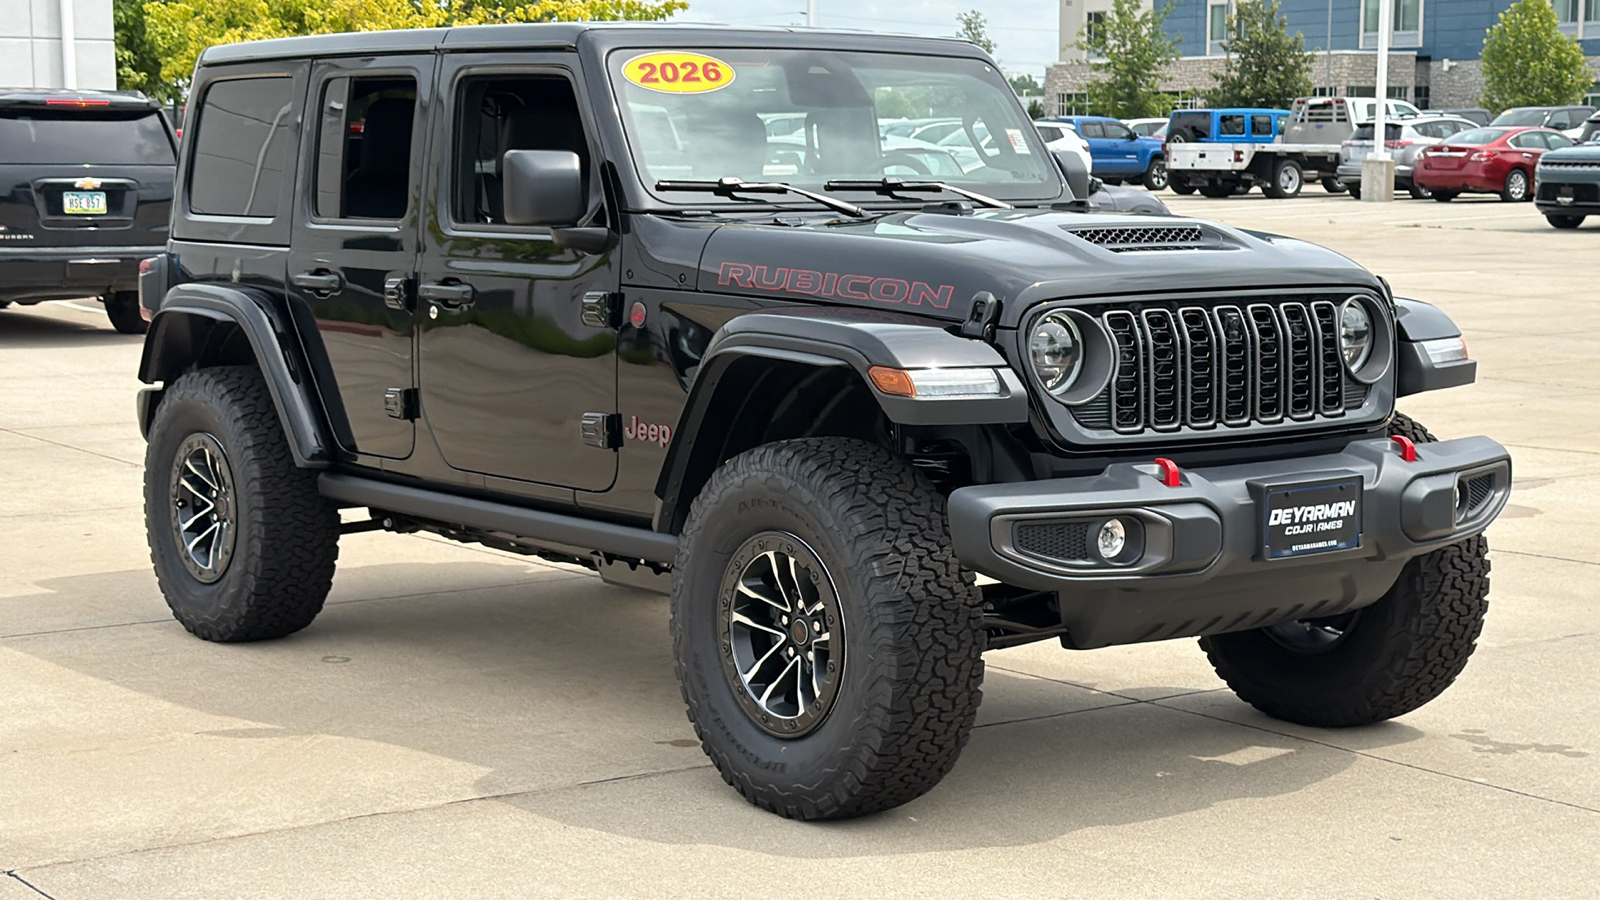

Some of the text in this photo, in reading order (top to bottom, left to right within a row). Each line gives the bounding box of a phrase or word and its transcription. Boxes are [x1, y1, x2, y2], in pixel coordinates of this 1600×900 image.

[638, 62, 722, 83] 2026
[718, 262, 954, 309] RUBICON
[625, 415, 672, 448] Jeep
[1268, 500, 1355, 526] DEYARMAN
